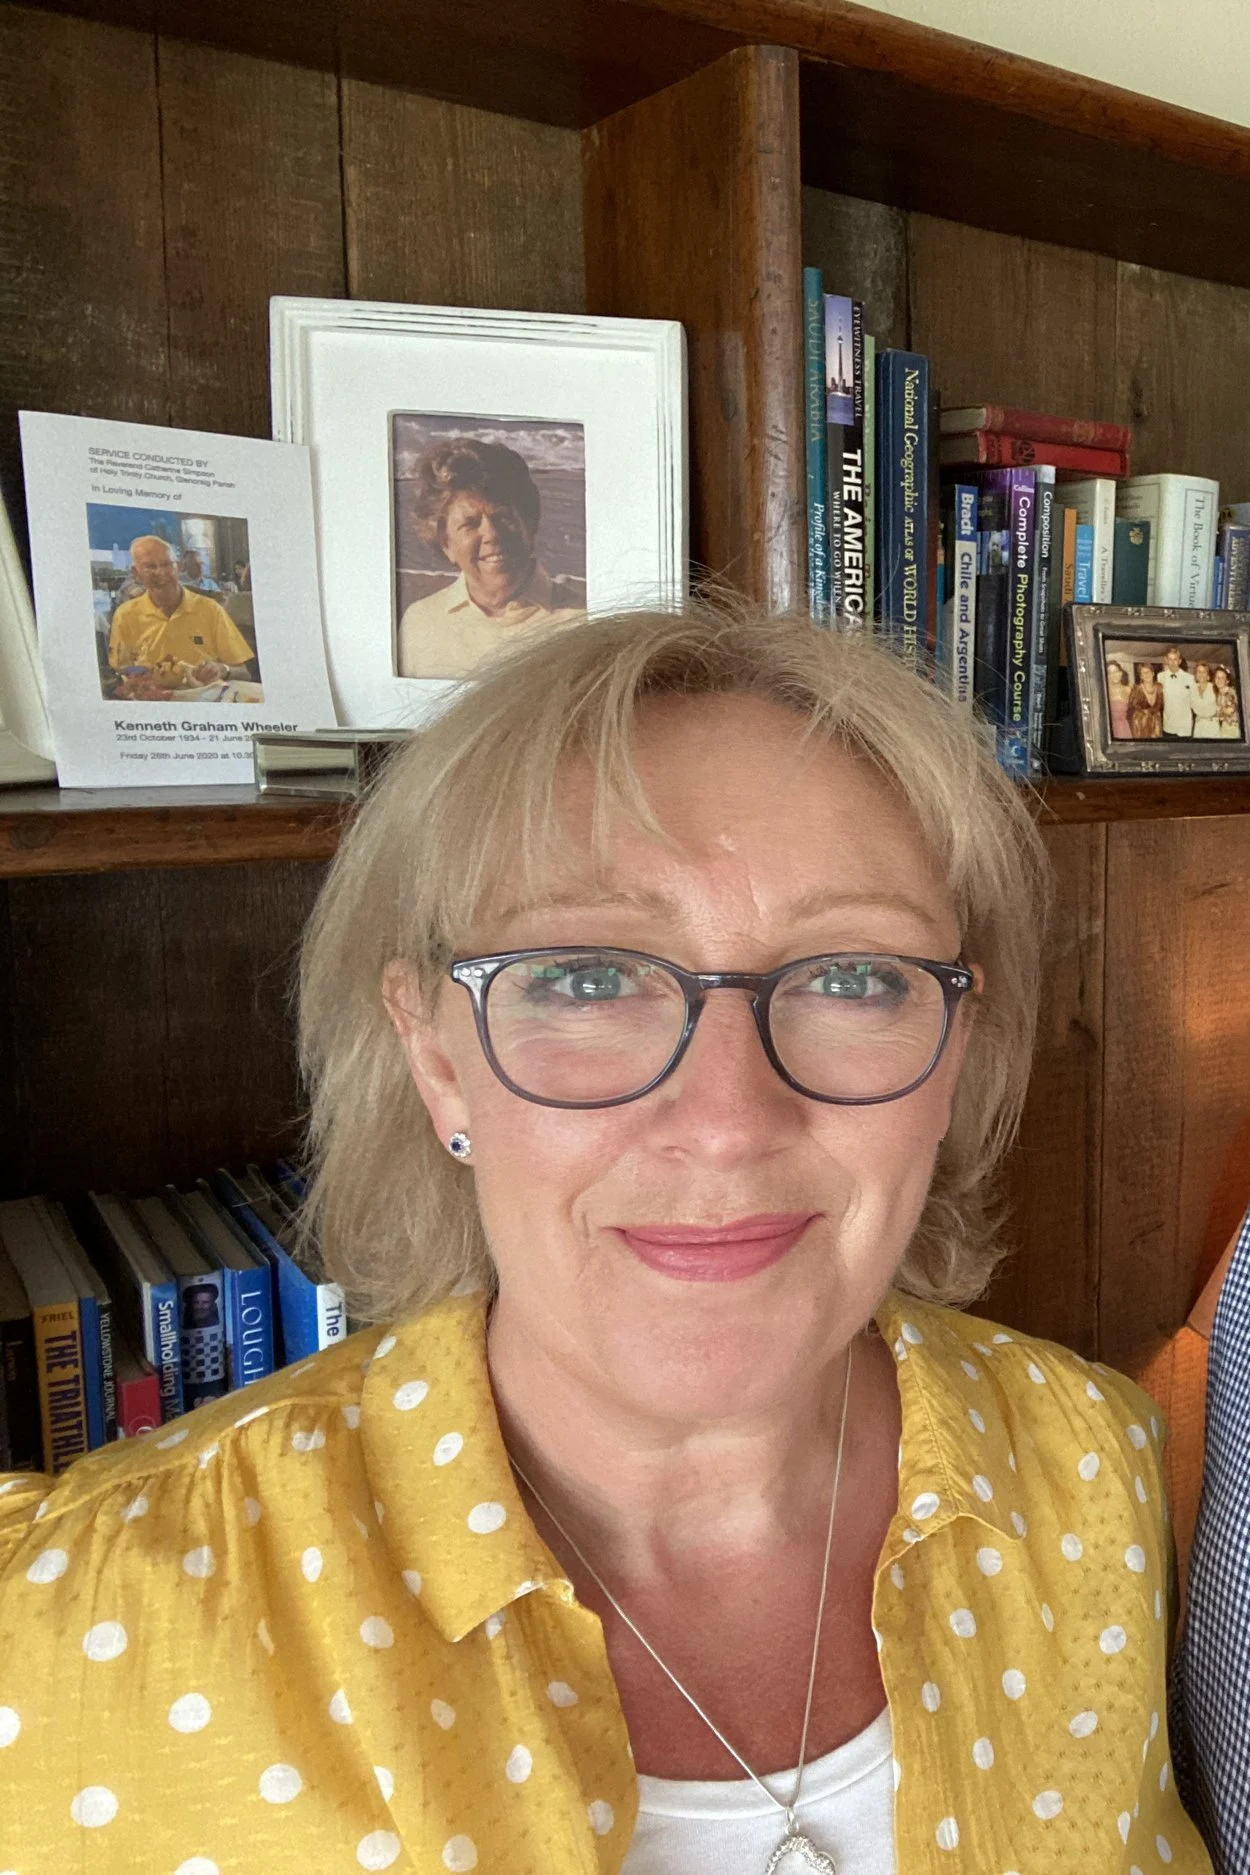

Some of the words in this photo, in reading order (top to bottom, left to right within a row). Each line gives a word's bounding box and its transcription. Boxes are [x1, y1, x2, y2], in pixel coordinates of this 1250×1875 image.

[853, 306, 864, 374] EYEWITNESS
[854, 376, 864, 418] TRAVEL
[904, 367, 920, 430] National
[842, 449, 863, 502] THE
[900, 432, 919, 514] Geographic
[91, 484, 101, 493] In
[102, 485, 133, 498] Loving
[135, 488, 171, 501] Memory
[172, 493, 183, 501] of
[832, 491, 842, 530] WHERE
[1193, 495, 1207, 519] The
[813, 502, 827, 542] Profile
[904, 516, 915, 546] ATLAS
[960, 492, 975, 536] Bradt
[1015, 495, 1031, 569] Complete
[1040, 490, 1054, 559] Composition
[814, 542, 828, 559] of
[833, 533, 842, 548] TO
[904, 548, 915, 562] OF
[1191, 520, 1205, 552] Book
[833, 550, 843, 569] GO
[959, 552, 973, 590] Chile
[1064, 562, 1074, 595] Saudi
[1190, 554, 1203, 568] of
[904, 563, 918, 622] WORLD
[1077, 562, 1091, 599] Travel
[959, 595, 972, 623] and
[1011, 573, 1029, 667] Photography
[1012, 671, 1026, 722] Course
[114, 720, 178, 732] Kenneth
[180, 721, 239, 733] Graham
[240, 721, 299, 733] Wheeler
[139, 734, 176, 742] October
[222, 734, 244, 743] June
[119, 752, 149, 761] Friday
[173, 752, 195, 761] June
[41, 1309, 75, 1325] FRIEL
[325, 1302, 343, 1338] The
[43, 1330, 79, 1374] THE
[99, 1312, 114, 1378] YELLOWSTONE
[158, 1300, 178, 1398] Smallholding
[103, 1380, 117, 1423] JOURNAL
